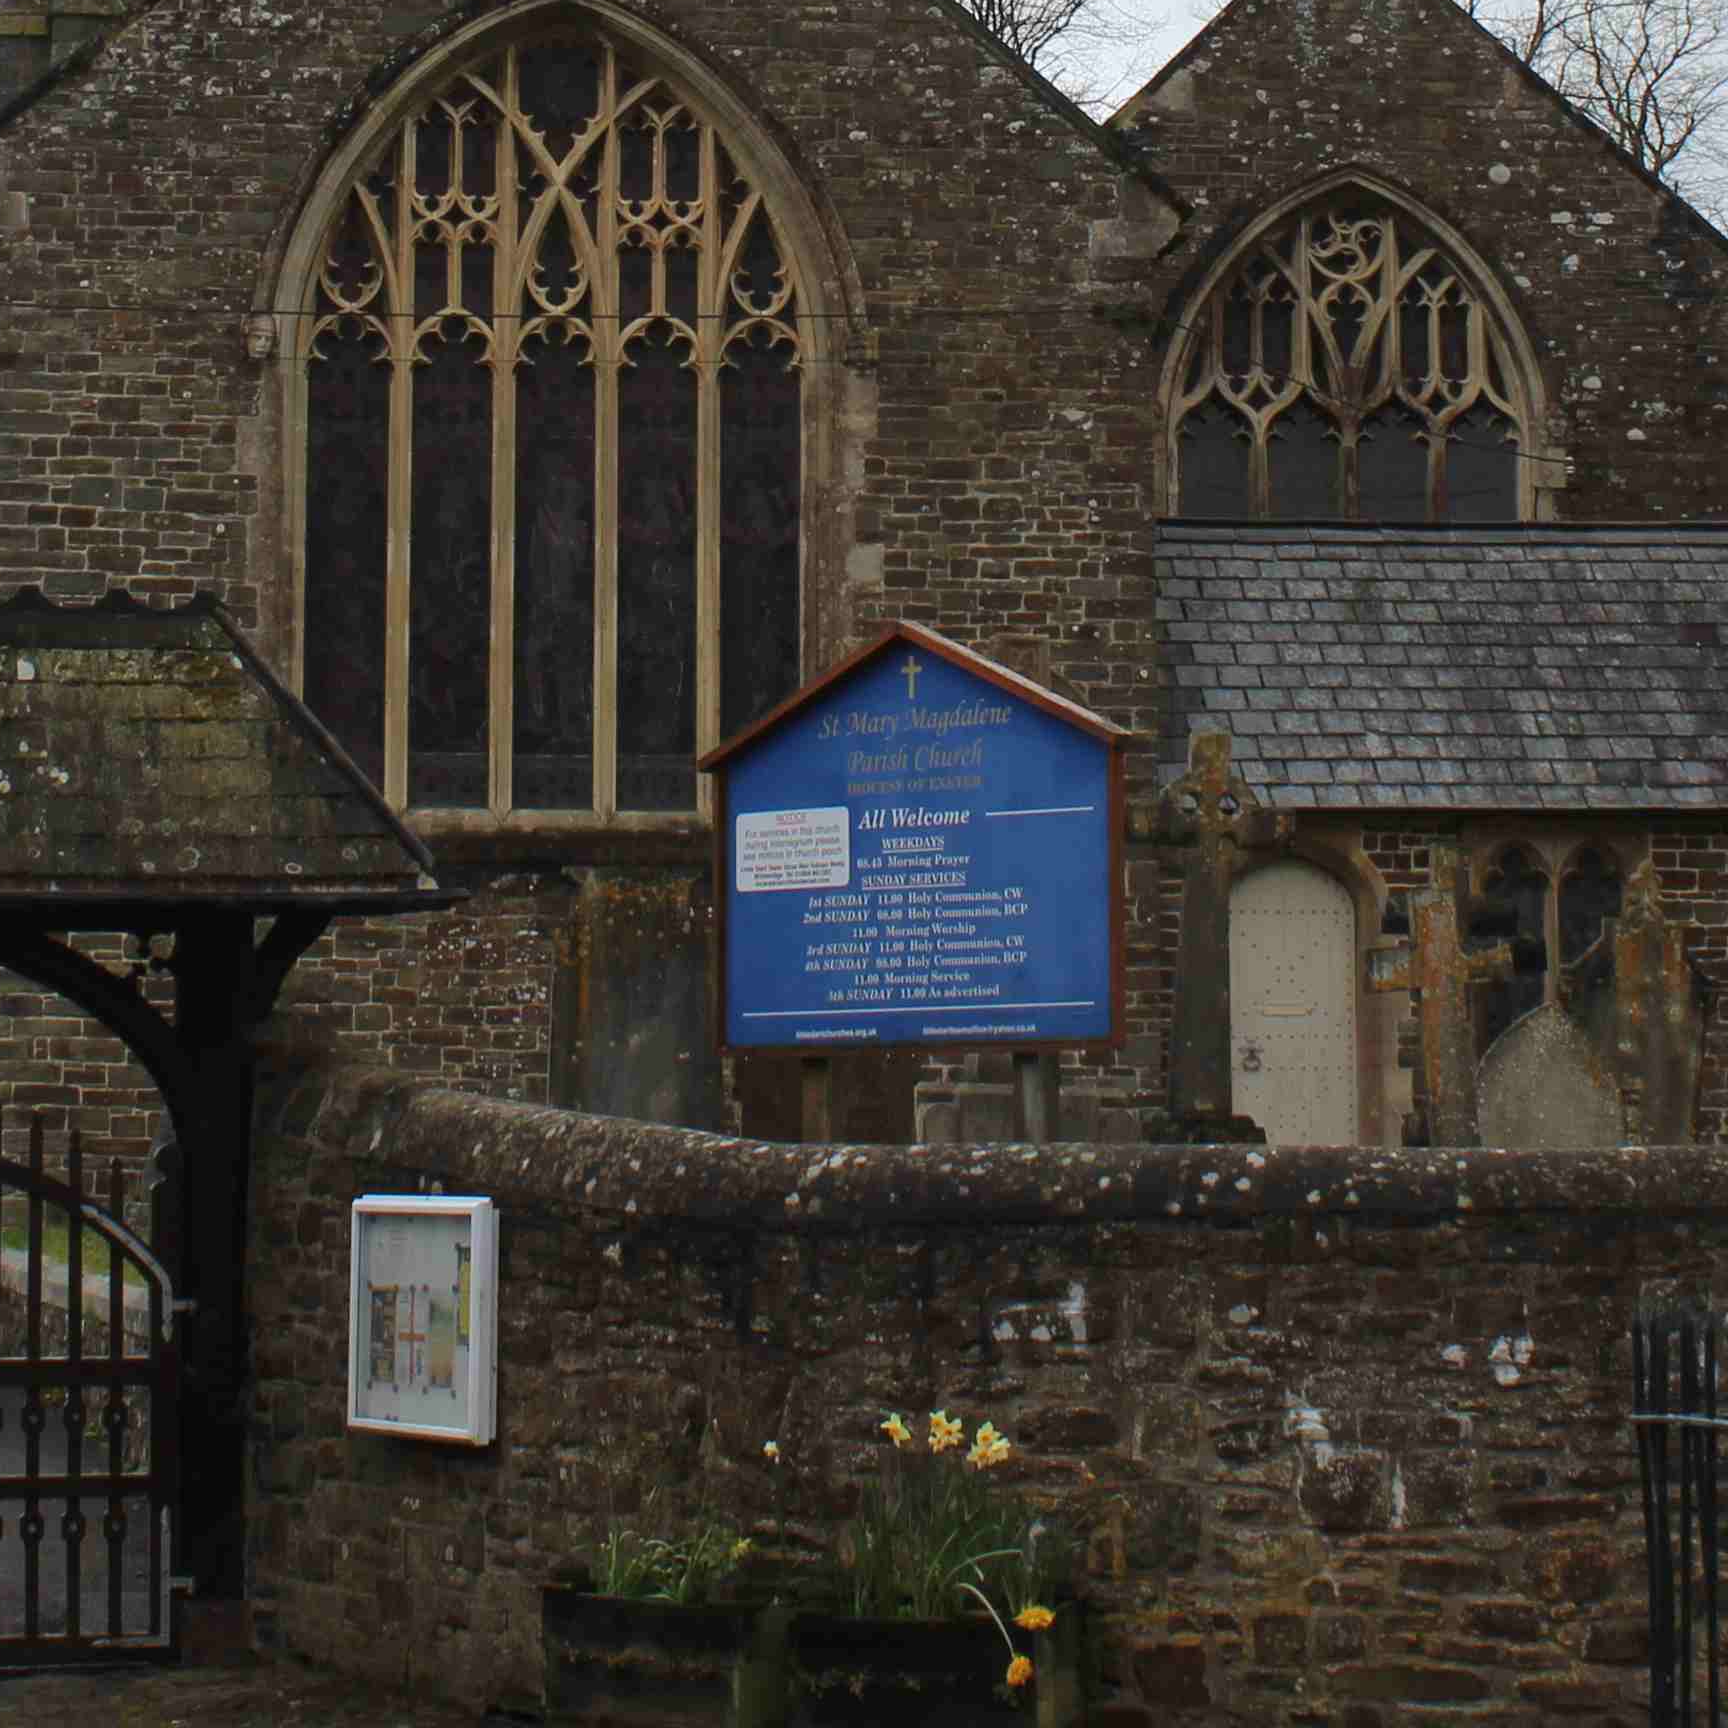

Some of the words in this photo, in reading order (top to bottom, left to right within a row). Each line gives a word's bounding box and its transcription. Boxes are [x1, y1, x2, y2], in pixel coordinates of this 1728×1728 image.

[846, 710, 899, 743] Mary
[904, 698, 1012, 736] Magdalene
[848, 741, 908, 773] Parish
[914, 738, 983, 771] Church
[858, 809, 885, 829] All
[891, 807, 970, 828] Welcome
[881, 835, 944, 849] WEEKDAYS
[888, 855, 931, 869] Morning
[934, 853, 970, 868] Prayer
[862, 873, 907, 887] SUNDAY
[910, 871, 966, 885] SERVICES
[824, 894, 870, 907] SUNDAY
[878, 894, 903, 905] 11.00
[908, 890, 930, 904] Holy
[1004, 887, 1024, 899] CW
[824, 910, 870, 923] SUNDAY
[908, 907, 930, 920] Holy
[1004, 903, 1028, 915] BCP
[853, 927, 878, 939] 11.00
[886, 925, 930, 937] Morning
[932, 922, 976, 935] Worship
[825, 941, 872, 954] SUNDAY
[879, 941, 905, 953] 11.00
[910, 939, 932, 952] Holy
[1006, 935, 1024, 947] CW
[823, 958, 868, 970] SUNDAY
[907, 954, 930, 968] Holy
[1003, 951, 1027, 963] BCP
[855, 974, 880, 985] 11.00
[885, 972, 929, 985] Morning
[931, 969, 970, 982] Service
[847, 987, 894, 1001] SUNDAY
[900, 987, 927, 999] 11.00
[928, 985, 942, 998] As
[943, 984, 1000, 997] advertised
